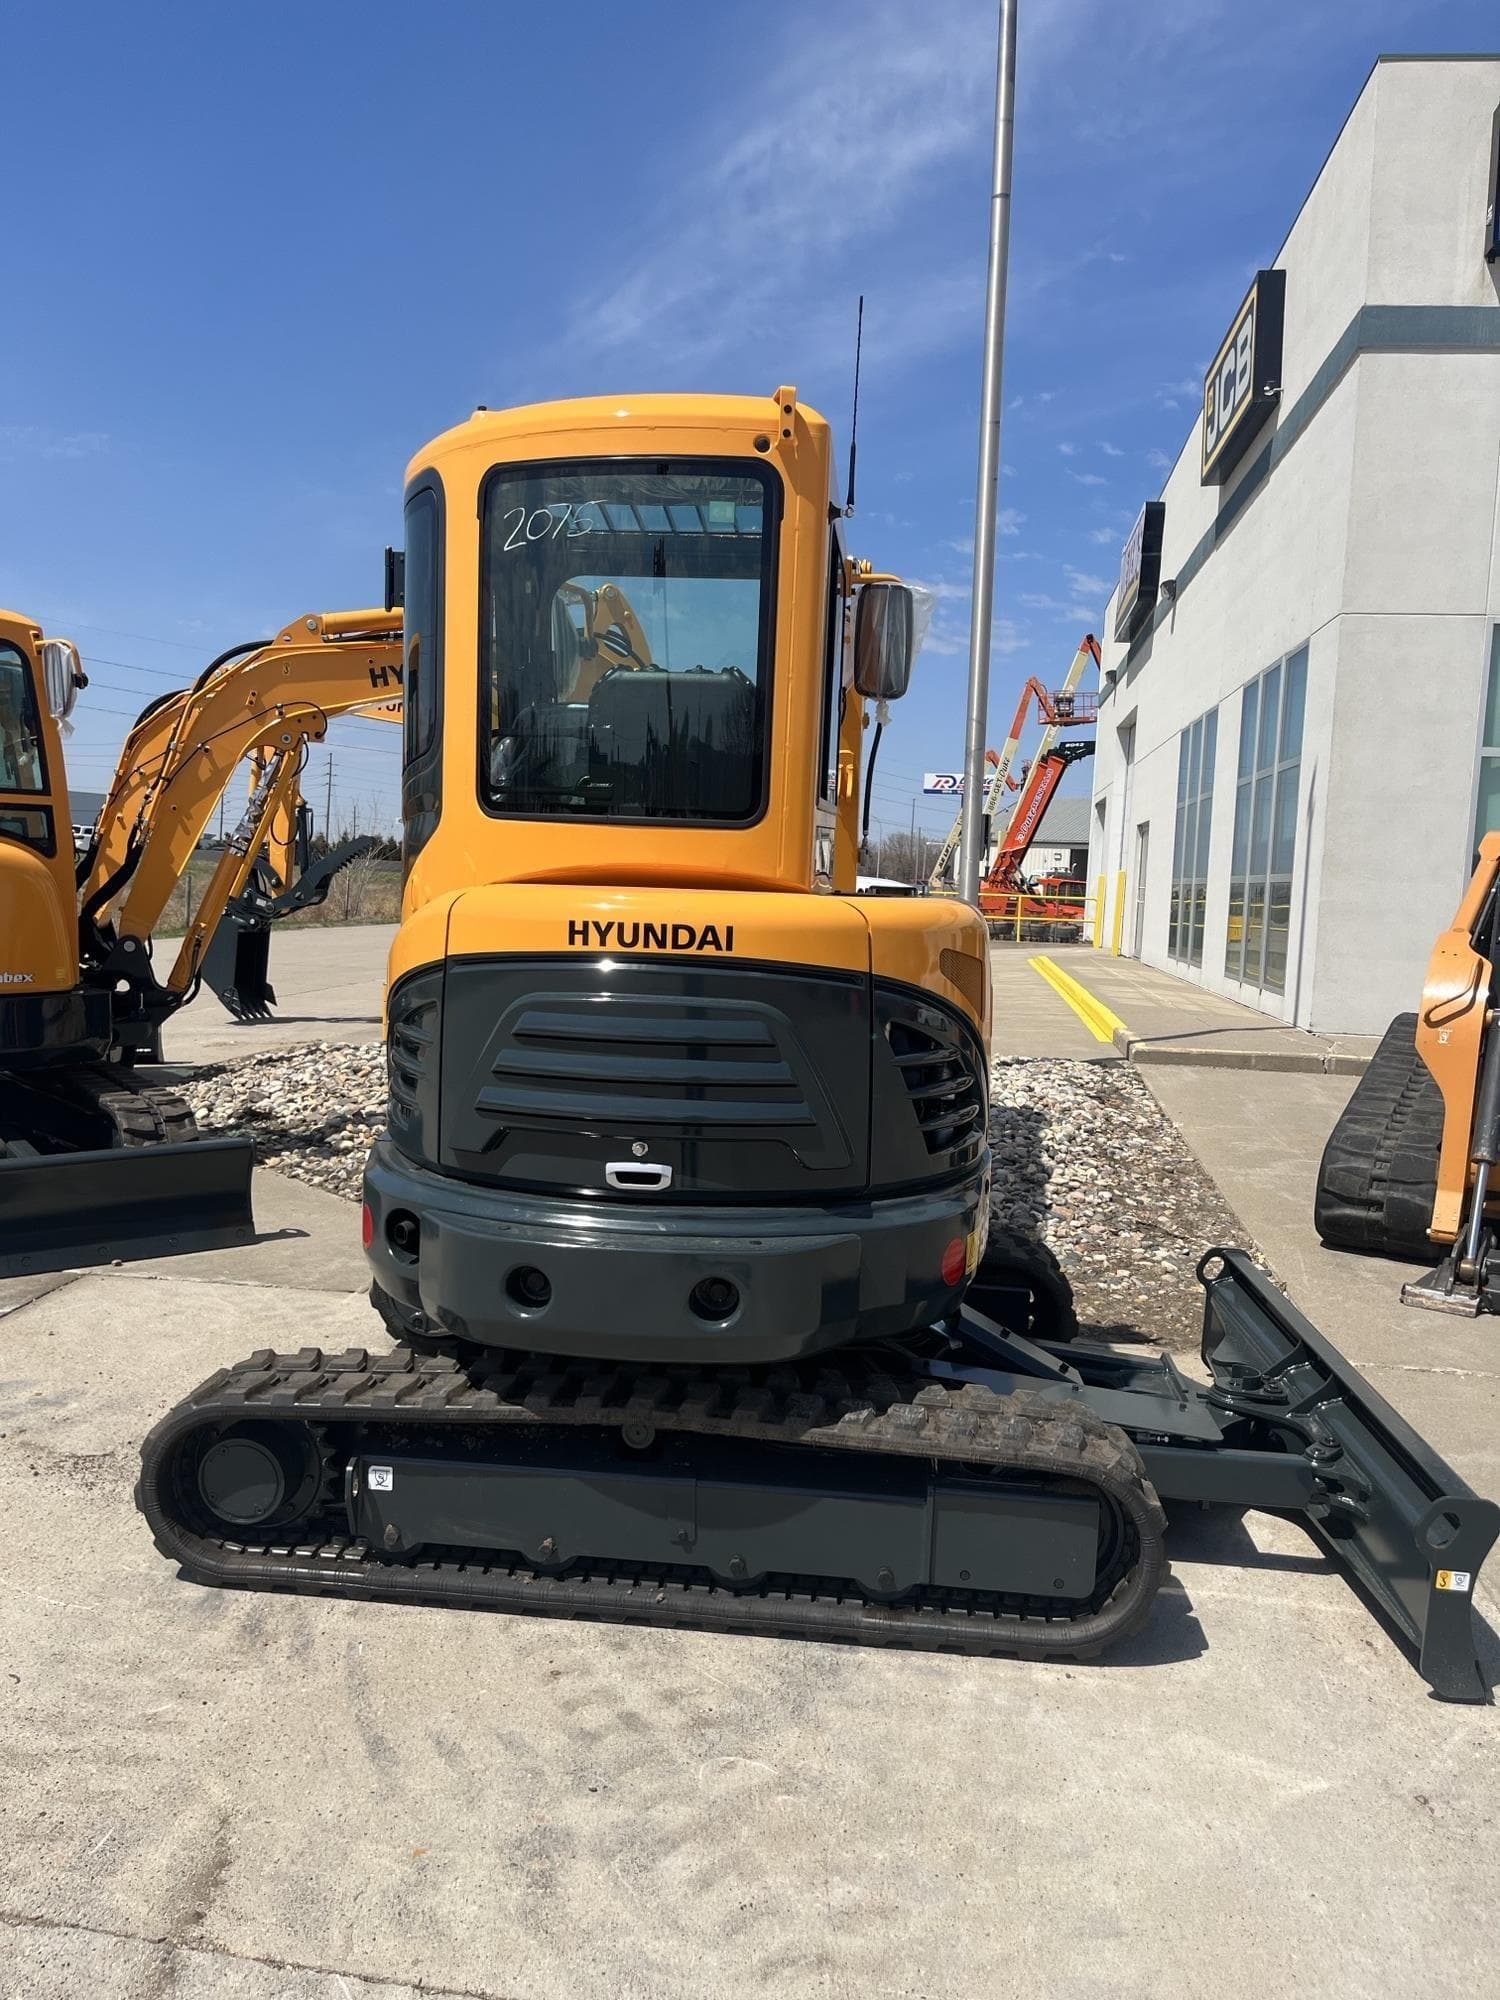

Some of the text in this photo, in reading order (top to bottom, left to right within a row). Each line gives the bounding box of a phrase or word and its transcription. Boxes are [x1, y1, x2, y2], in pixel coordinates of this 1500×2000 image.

[1207, 313, 1253, 454] JCB
[503, 499, 608, 551] 2075
[568, 920, 734, 951] HYUNDAI
[0, 971, 33, 983] bex
